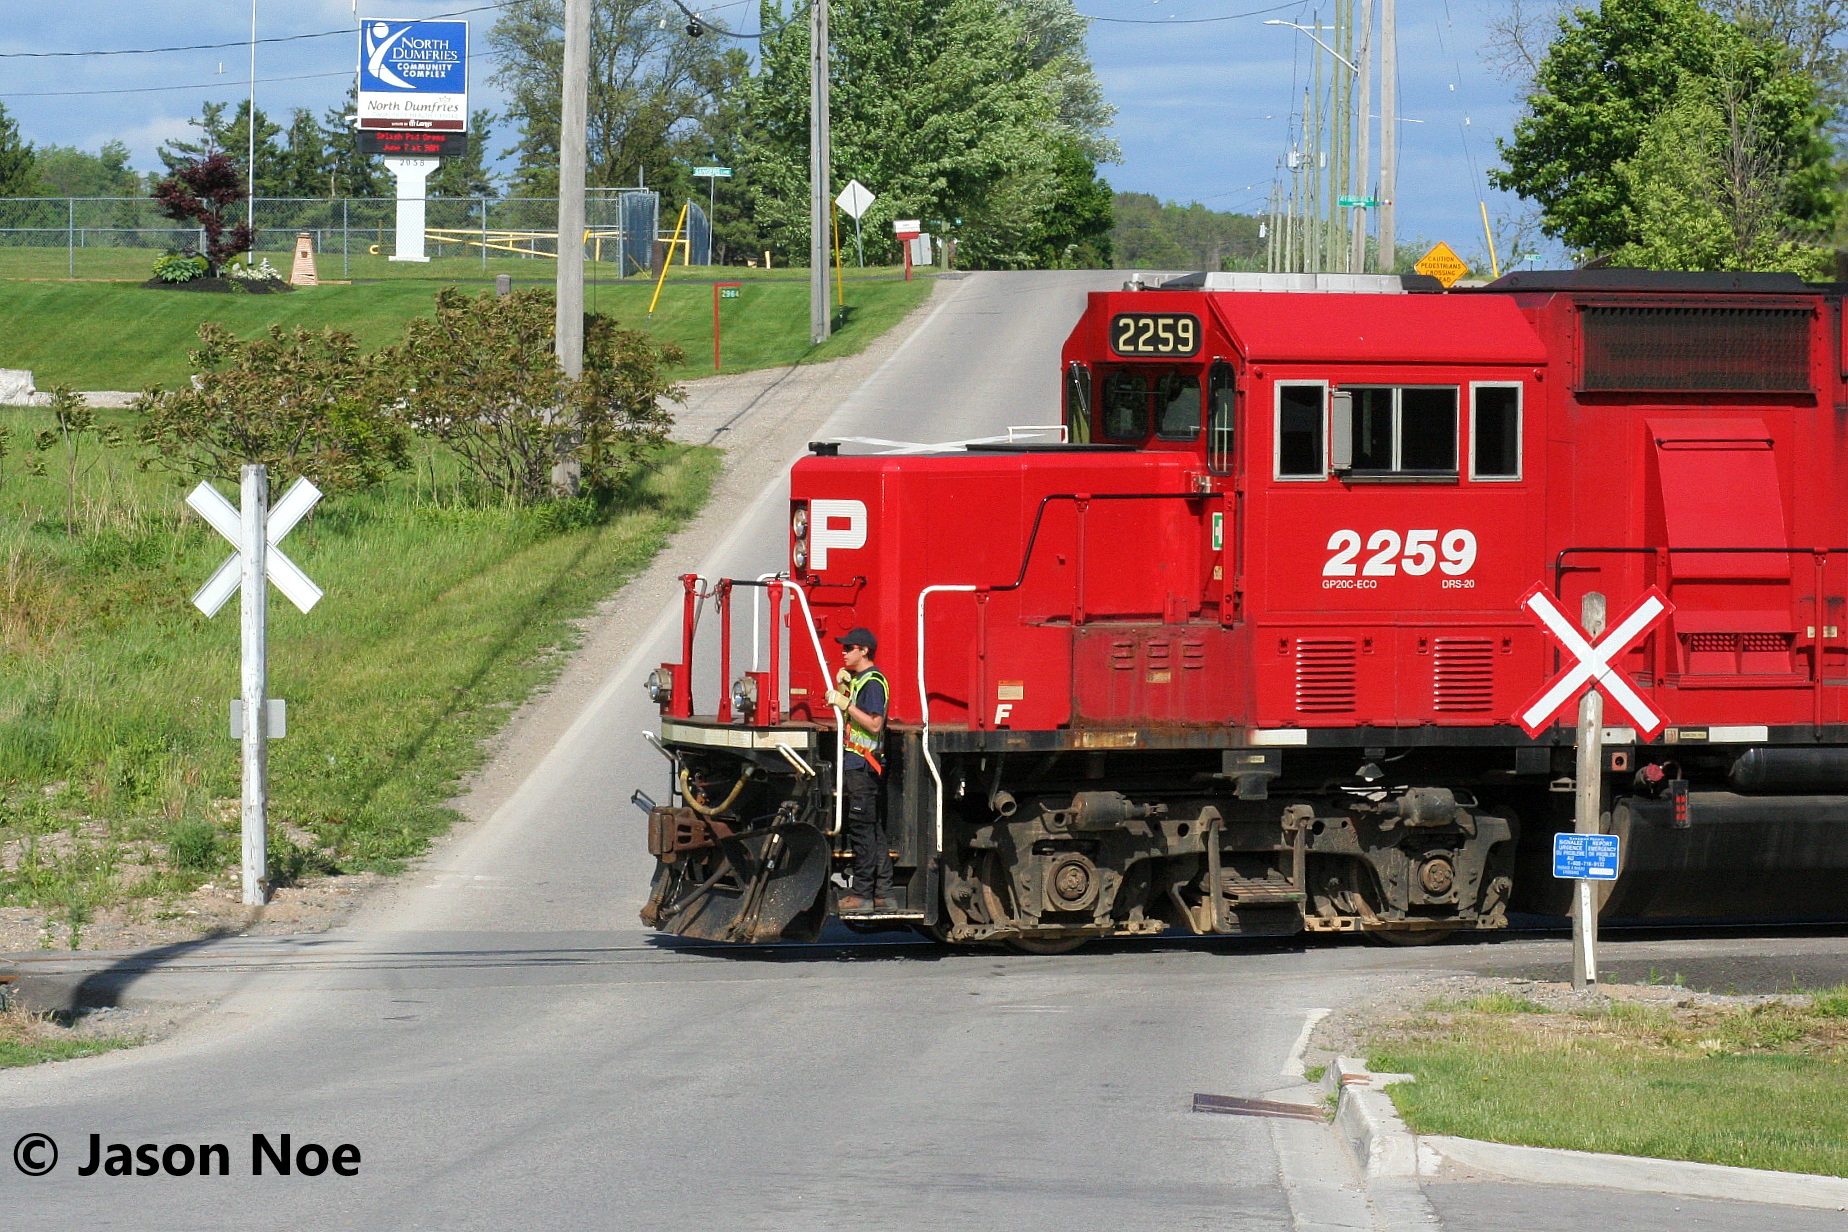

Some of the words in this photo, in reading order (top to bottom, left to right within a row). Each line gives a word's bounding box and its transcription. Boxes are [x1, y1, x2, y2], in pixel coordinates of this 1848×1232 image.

[402, 37, 448, 50] NORTH
[393, 48, 458, 60] DUMFRIES
[368, 100, 400, 110] North
[404, 100, 458, 112] Dumfries
[1118, 318, 1194, 352] 2259
[810, 499, 867, 570] P
[1322, 528, 1478, 576] 2259
[1322, 580, 1378, 589] GP20C-ECO
[1442, 580, 1475, 588] DRS-20
[994, 704, 1013, 724] F
